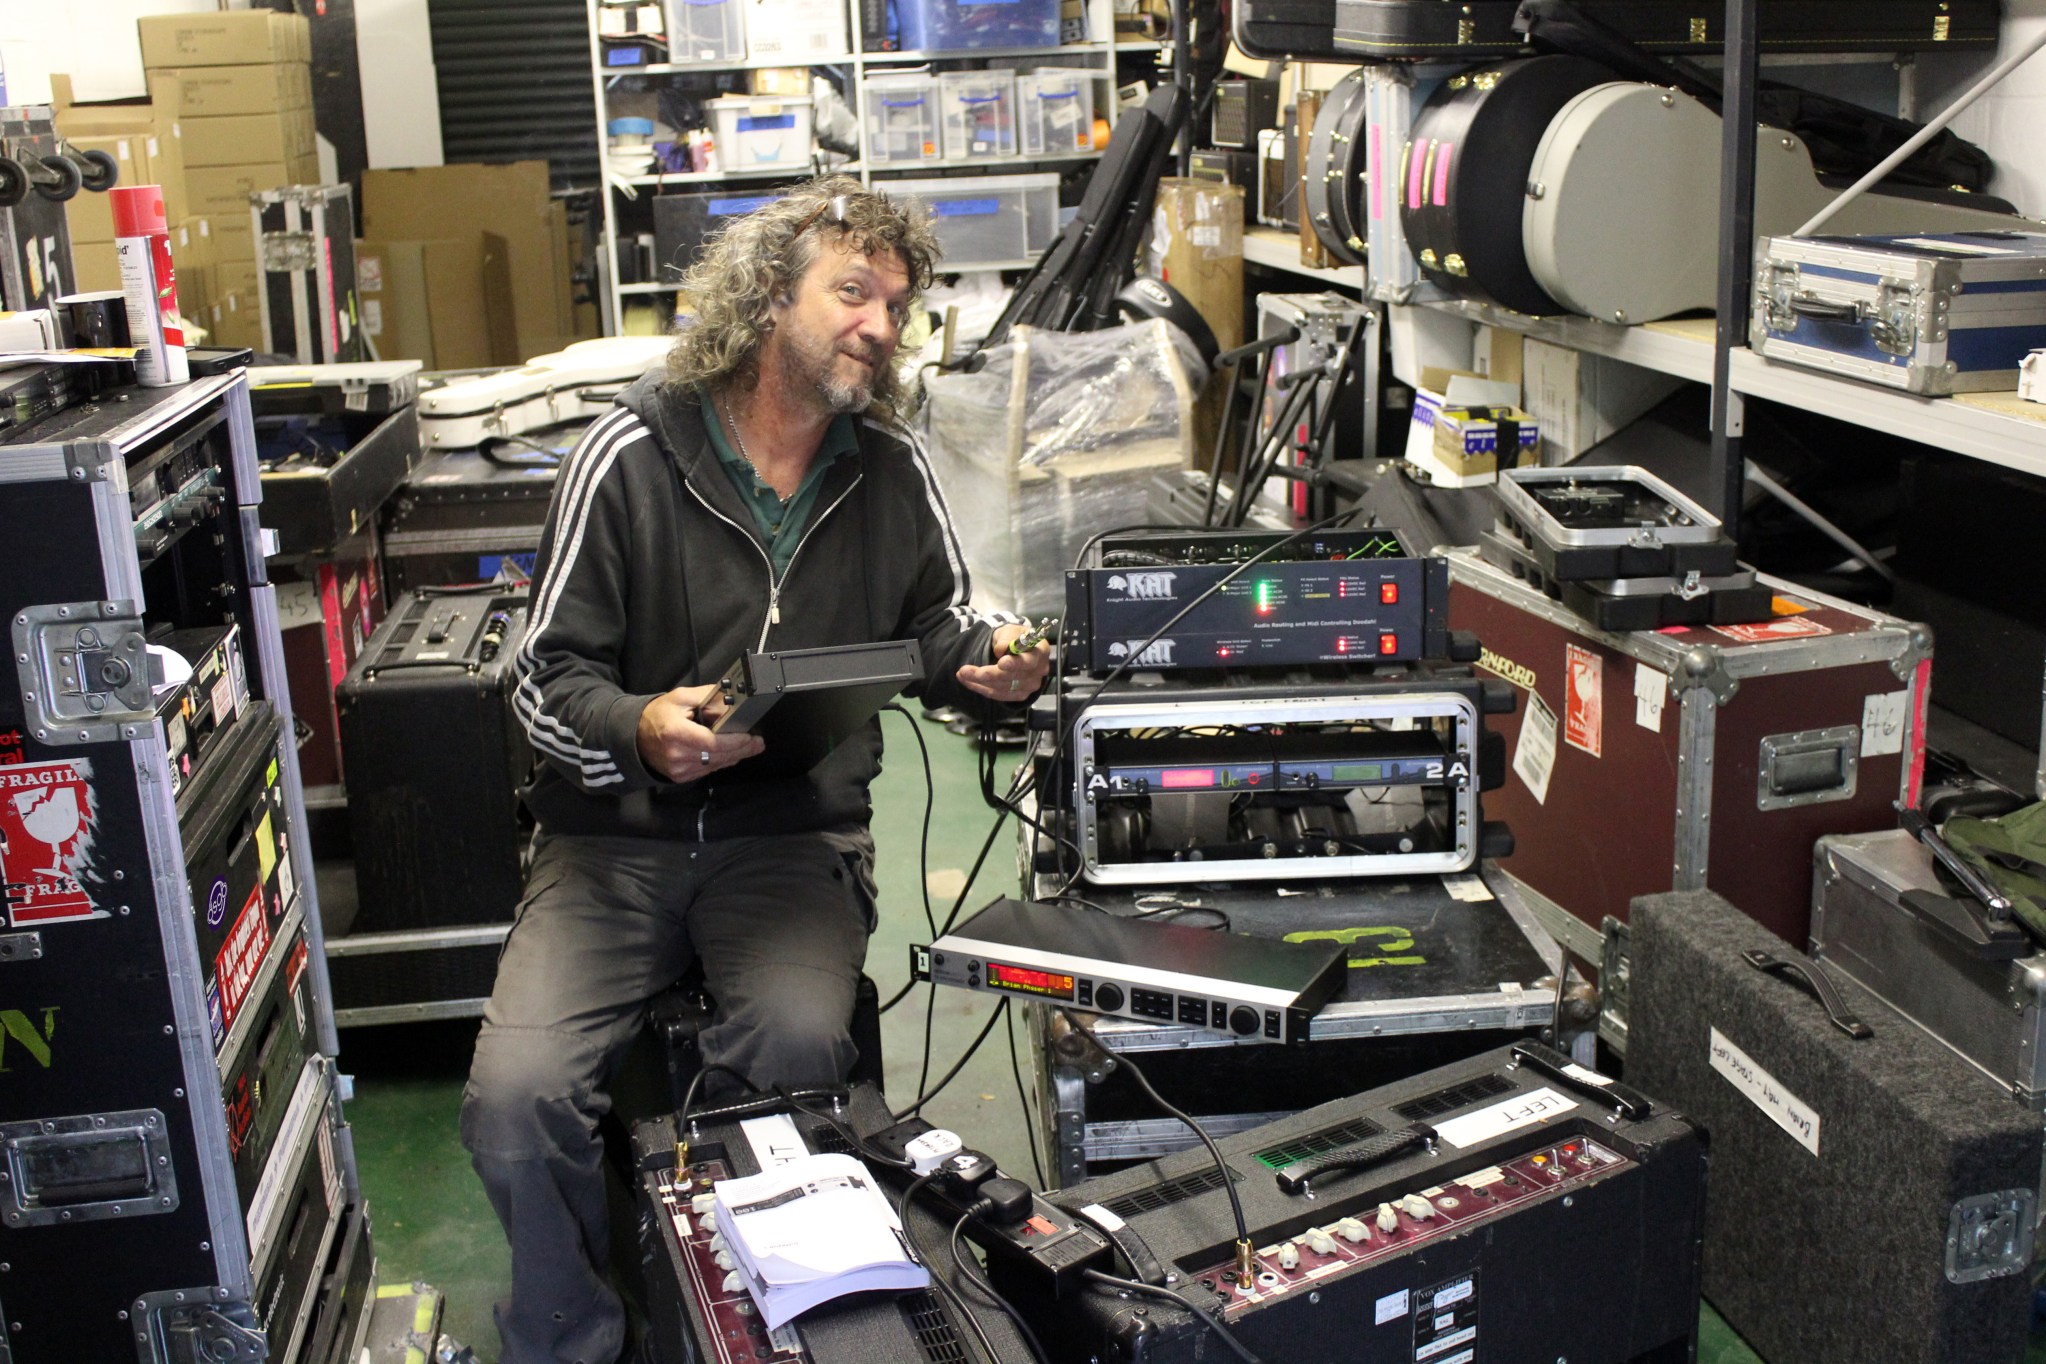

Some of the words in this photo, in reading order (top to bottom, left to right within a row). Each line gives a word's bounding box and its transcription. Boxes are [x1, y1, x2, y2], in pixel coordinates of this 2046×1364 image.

[1126, 572, 1177, 597] KAT
[1866, 708, 1896, 738] 46
[1088, 773, 1122, 790] A1
[920, 956, 926, 967] 1
[1002, 980, 1020, 989] Brian
[1022, 983, 1045, 993] Phaser
[1063, 976, 1073, 989] 5
[1502, 1096, 1559, 1123] LEFT
[952, 1154, 980, 1169] 4
[1421, 1289, 1435, 1299] VOX
[1436, 1274, 1474, 1294] AMPLIFIER
